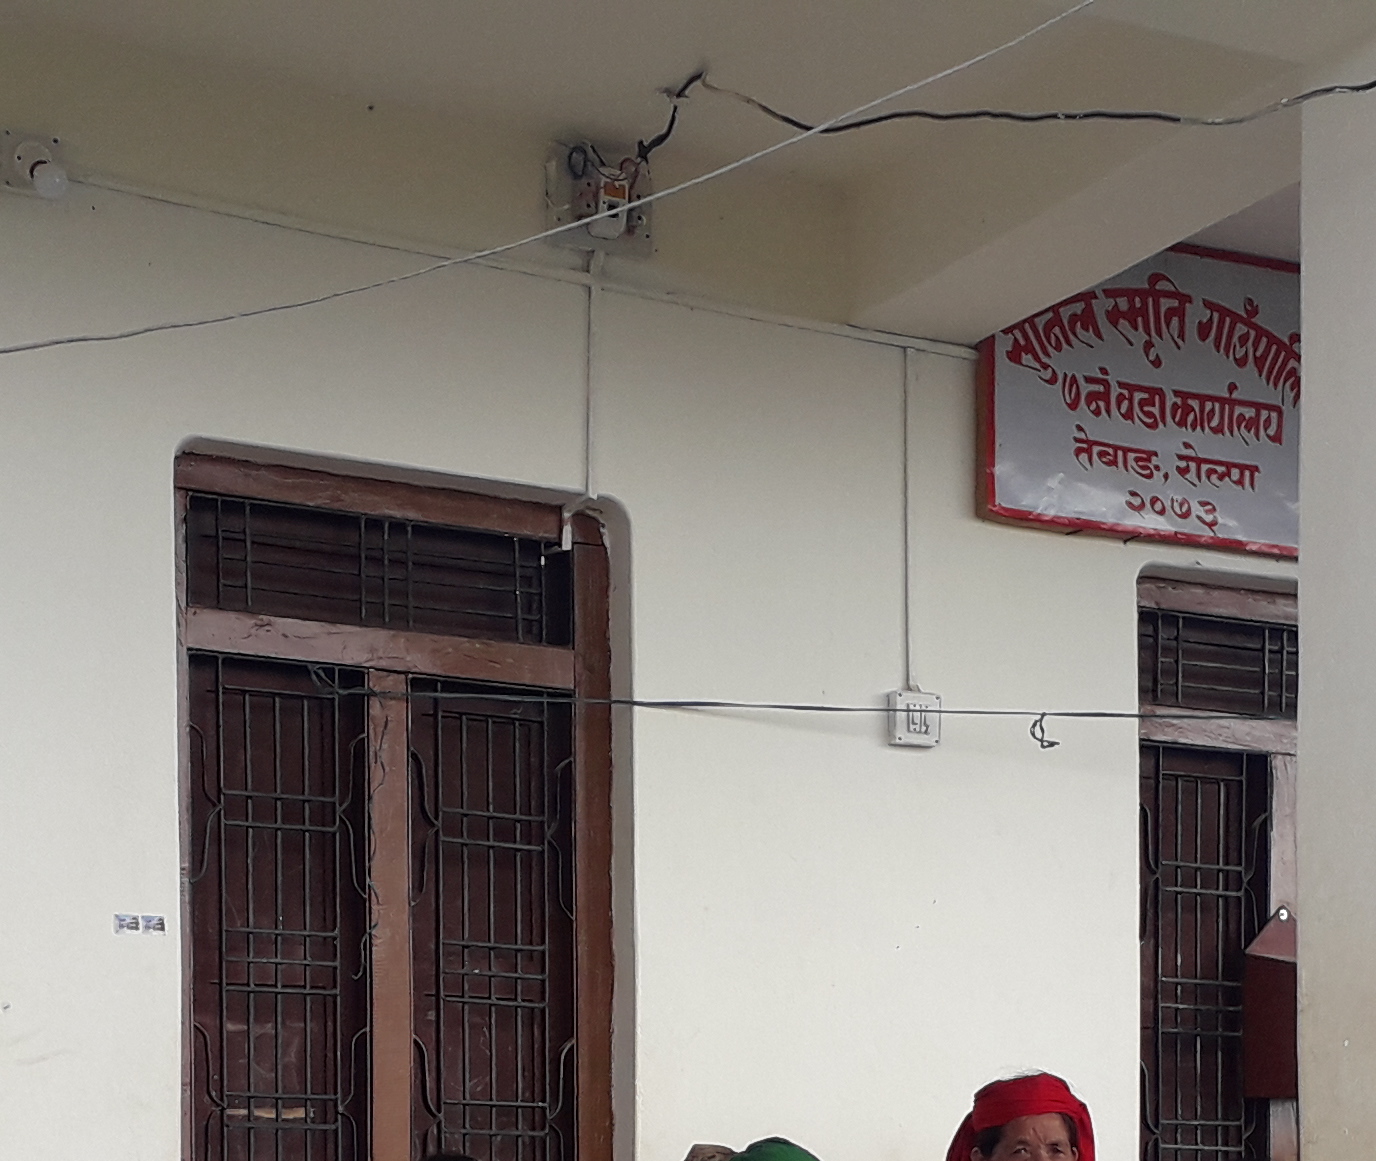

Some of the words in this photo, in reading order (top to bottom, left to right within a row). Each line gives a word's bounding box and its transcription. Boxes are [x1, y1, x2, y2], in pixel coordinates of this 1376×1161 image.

[1101, 271, 1193, 369] स्मृति
[1196, 296, 1301, 409] गाउँपालि
[1115, 379, 1167, 431] वडा
[1170, 381, 1284, 447] कार्यालय
[1175, 440, 1261, 493] रोल्पा
[1124, 489, 1220, 537] २०७३
